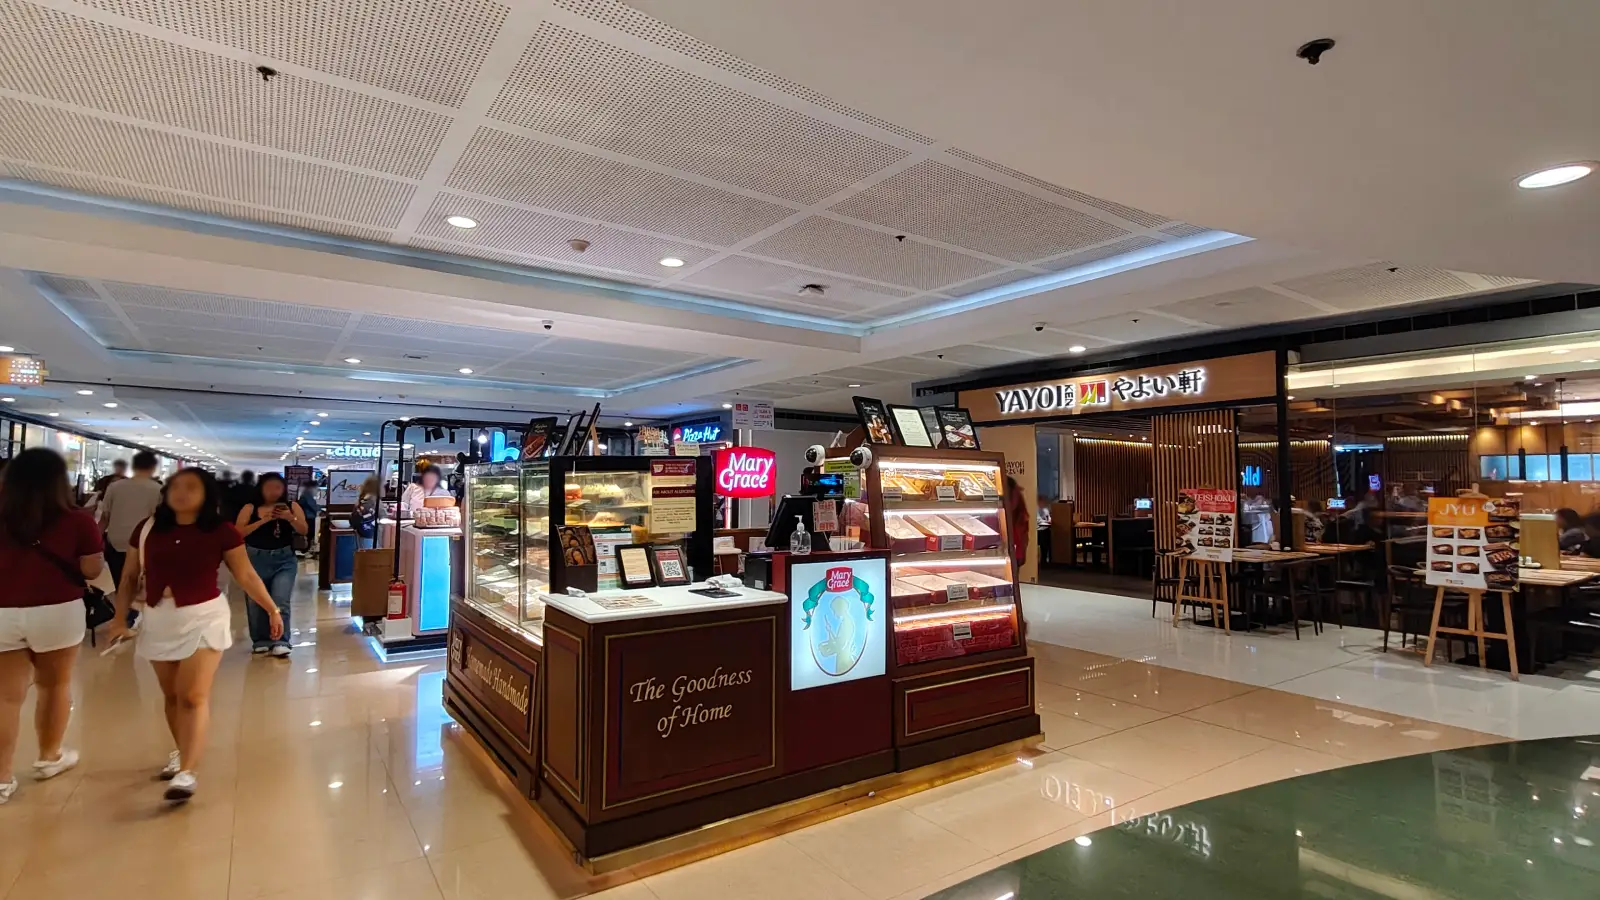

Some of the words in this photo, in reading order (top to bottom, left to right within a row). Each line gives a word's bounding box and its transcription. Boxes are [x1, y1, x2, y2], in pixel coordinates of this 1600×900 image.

[1064, 384, 1074, 407] KEN
[1112, 369, 1202, 401] やよい軒
[996, 385, 1062, 412] YAYOI
[683, 428, 703, 442] Pizza
[703, 426, 721, 442] Hut
[728, 452, 774, 473] Mary
[718, 469, 769, 491] Grace
[1194, 493, 1235, 502] TEISHOKU
[1439, 503, 1477, 516] JYU
[827, 578, 850, 590] Grace
[831, 570, 852, 580] Mary
[465, 646, 493, 686] Homemade
[492, 667, 529, 716] Handmade
[629, 677, 665, 704] The
[672, 667, 753, 702] Goodness
[656, 705, 684, 739] of
[679, 702, 734, 728] Home
